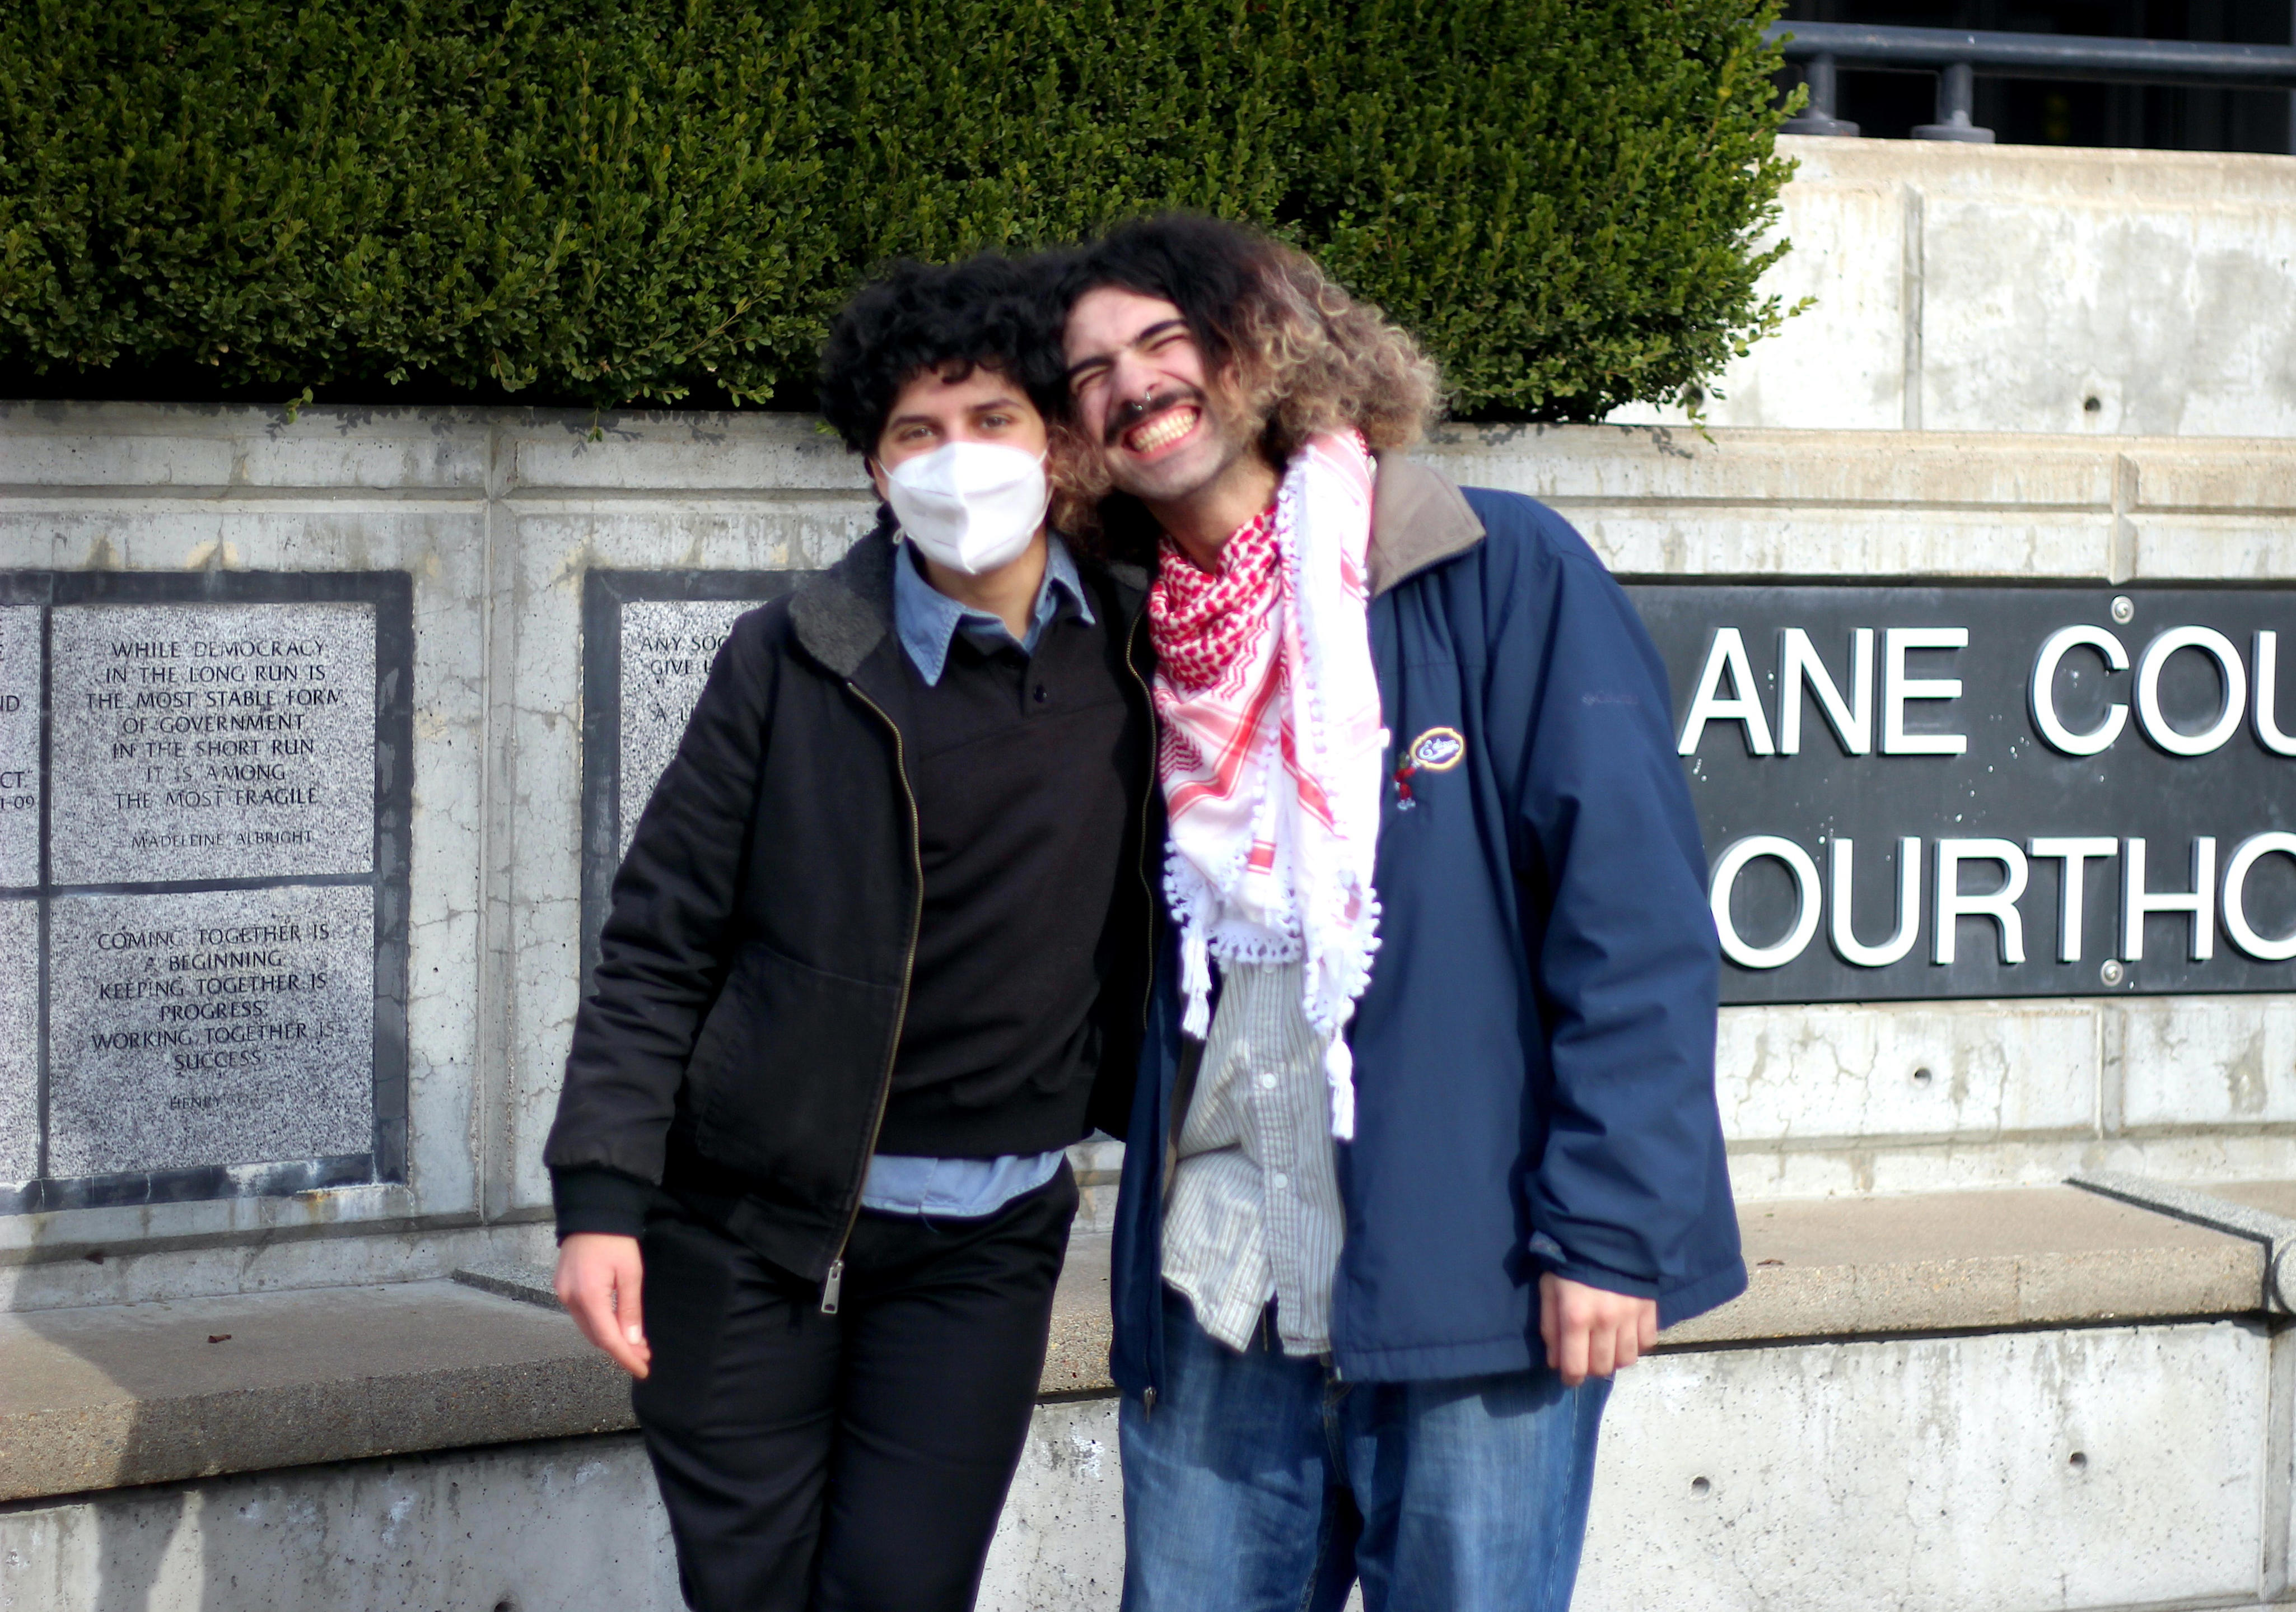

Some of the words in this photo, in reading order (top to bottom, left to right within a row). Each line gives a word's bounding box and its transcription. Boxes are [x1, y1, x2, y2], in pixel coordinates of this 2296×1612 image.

[111, 641, 180, 658] WHILE
[194, 640, 326, 658] DEMOCRACY
[640, 636, 682, 651] ANY
[106, 667, 127, 683] IN
[140, 667, 178, 683] THE
[190, 665, 244, 683] LONG
[255, 665, 297, 681] RUN
[310, 664, 326, 681] IS
[85, 693, 124, 710] THE
[137, 692, 195, 709] MOST
[207, 690, 276, 707] STABLE
[1677, 627, 1969, 756] ANE
[123, 718, 148, 734] OF
[160, 714, 305, 733] GOVERNMENT
[654, 707, 666, 722] A
[113, 742, 133, 759] IN
[146, 742, 186, 758] THE
[196, 740, 261, 757] SHORT
[272, 739, 314, 756] RUN
[147, 766, 164, 782] IT
[176, 766, 192, 782] IS
[206, 763, 285, 781] AMONG
[114, 793, 152, 809] THE
[166, 791, 224, 808] MOST
[235, 788, 319, 805] FRAGILE
[132, 833, 225, 849] MADELEINE
[235, 830, 312, 845] ALBRIGHT
[98, 930, 184, 950] COMING
[197, 925, 302, 945] TOGETHER
[313, 923, 329, 941] IS
[144, 957, 159, 973] A
[169, 950, 282, 972] BEGINNING
[100, 980, 184, 1000] KEEPING
[197, 975, 300, 995] TOGETHER
[311, 972, 328, 989] IS
[91, 1029, 192, 1051] WORKING
[204, 1023, 307, 1044] TOGETHER
[320, 1021, 335, 1037] IS
[174, 1050, 262, 1071] SUCCESS
[170, 1093, 225, 1110] HENRY
